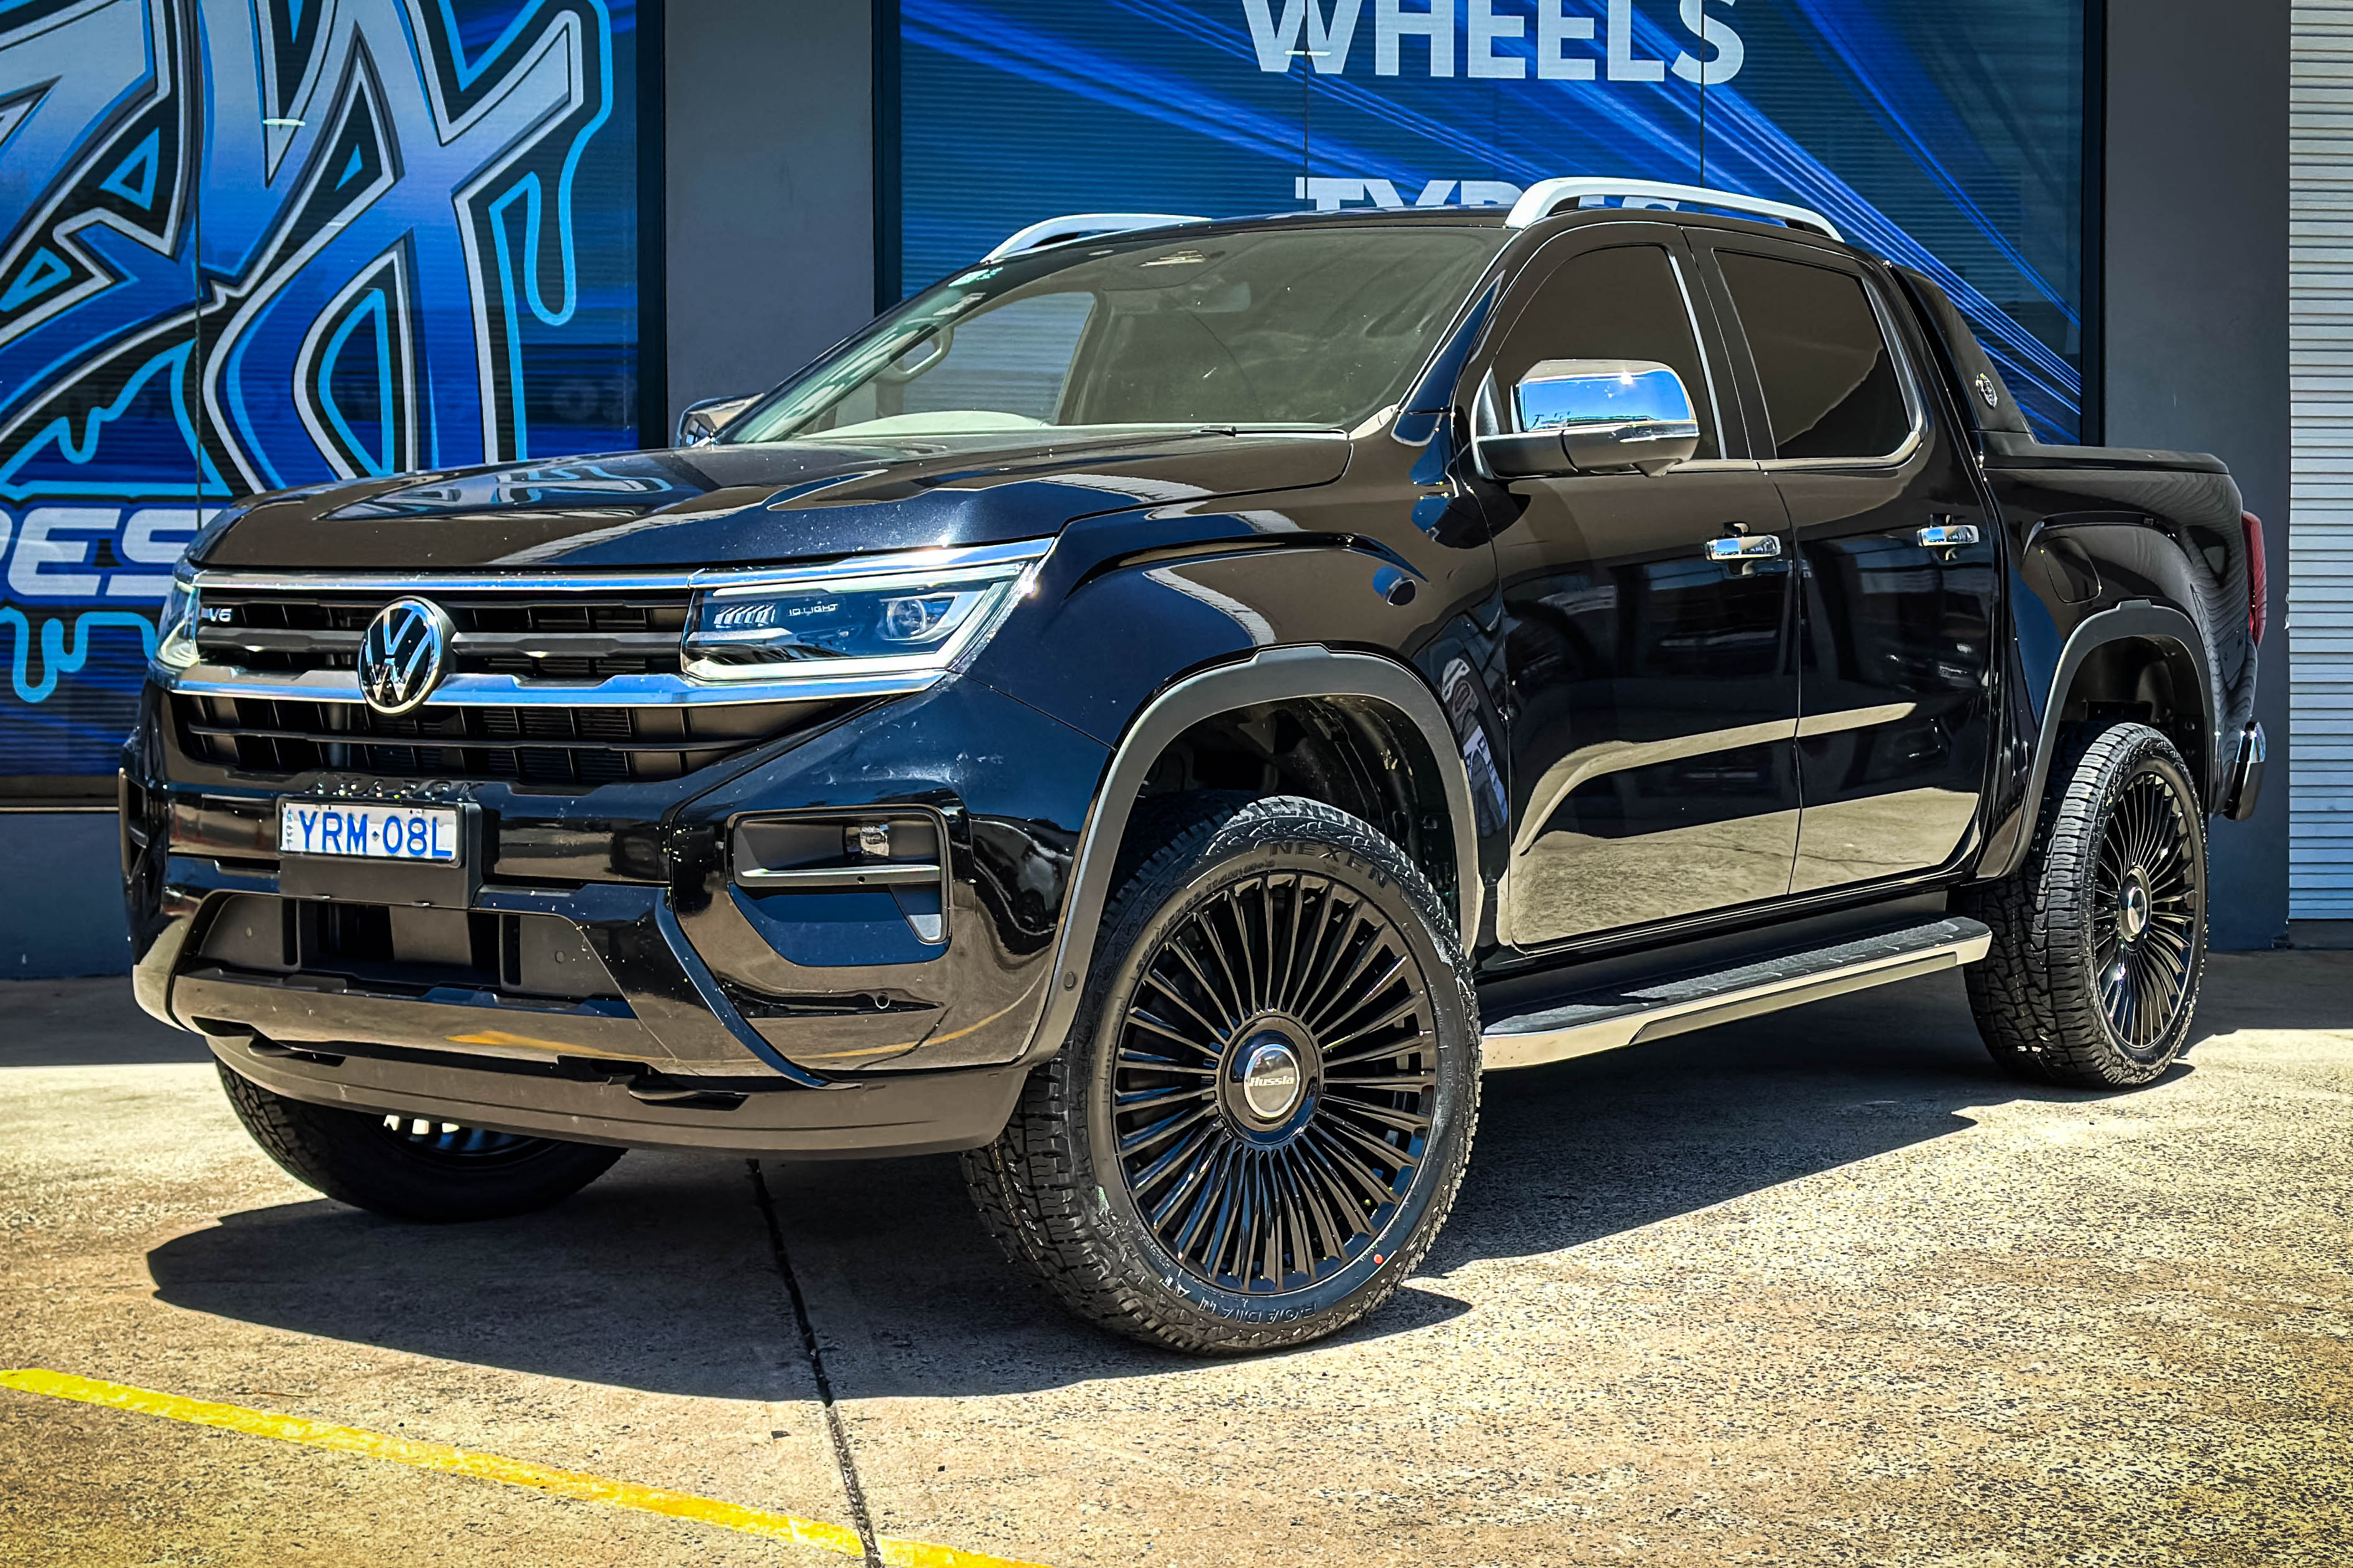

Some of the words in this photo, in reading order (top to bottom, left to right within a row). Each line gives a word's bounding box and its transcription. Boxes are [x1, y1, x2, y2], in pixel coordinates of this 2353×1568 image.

[1244, 0, 1744, 85] WHEELS
[209, 607, 232, 622] V6
[1269, 841, 1389, 889] NEXEN
